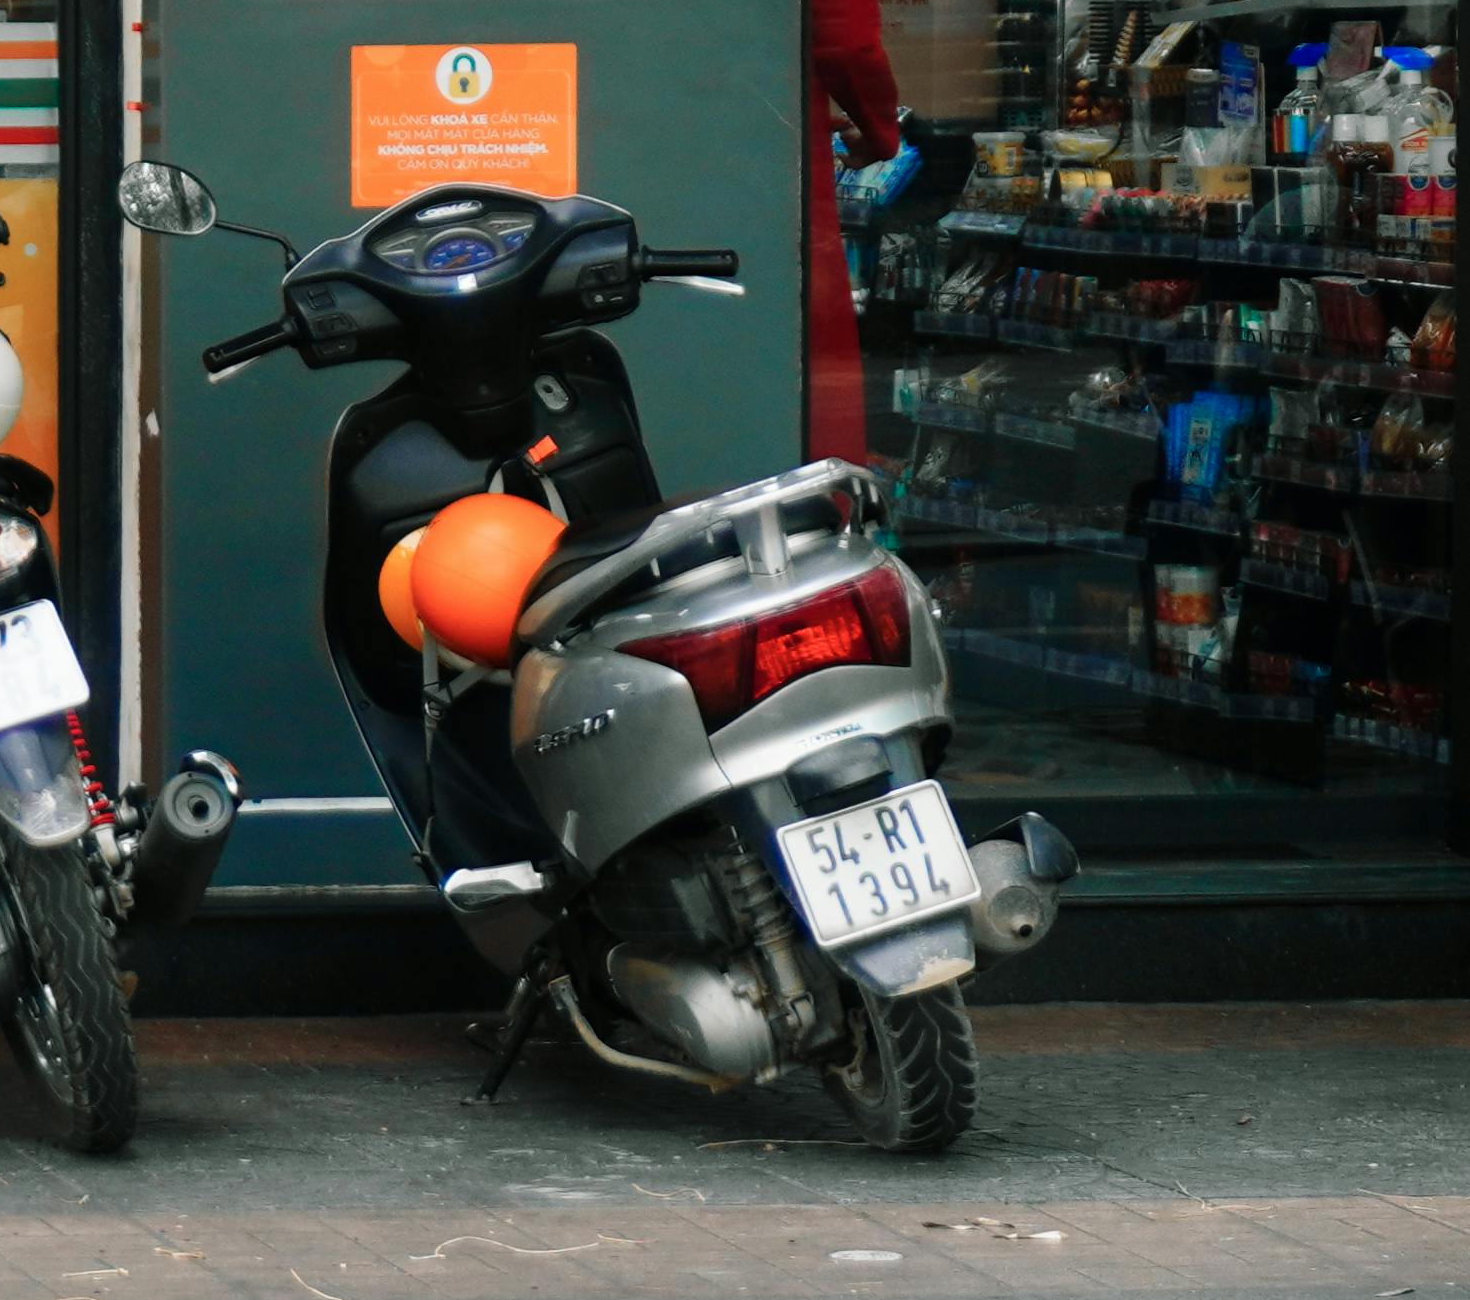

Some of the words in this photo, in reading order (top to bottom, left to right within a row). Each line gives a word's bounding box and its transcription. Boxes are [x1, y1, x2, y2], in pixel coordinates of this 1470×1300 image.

[429, 110, 469, 125] KHOÁ
[471, 113, 488, 125] XE
[377, 141, 425, 156] KHÔNG
[426, 145, 458, 158] CHỊU
[460, 140, 504, 155] TRÁCH
[805, 798, 927, 875] 54-R1
[827, 852, 951, 928] 1394
